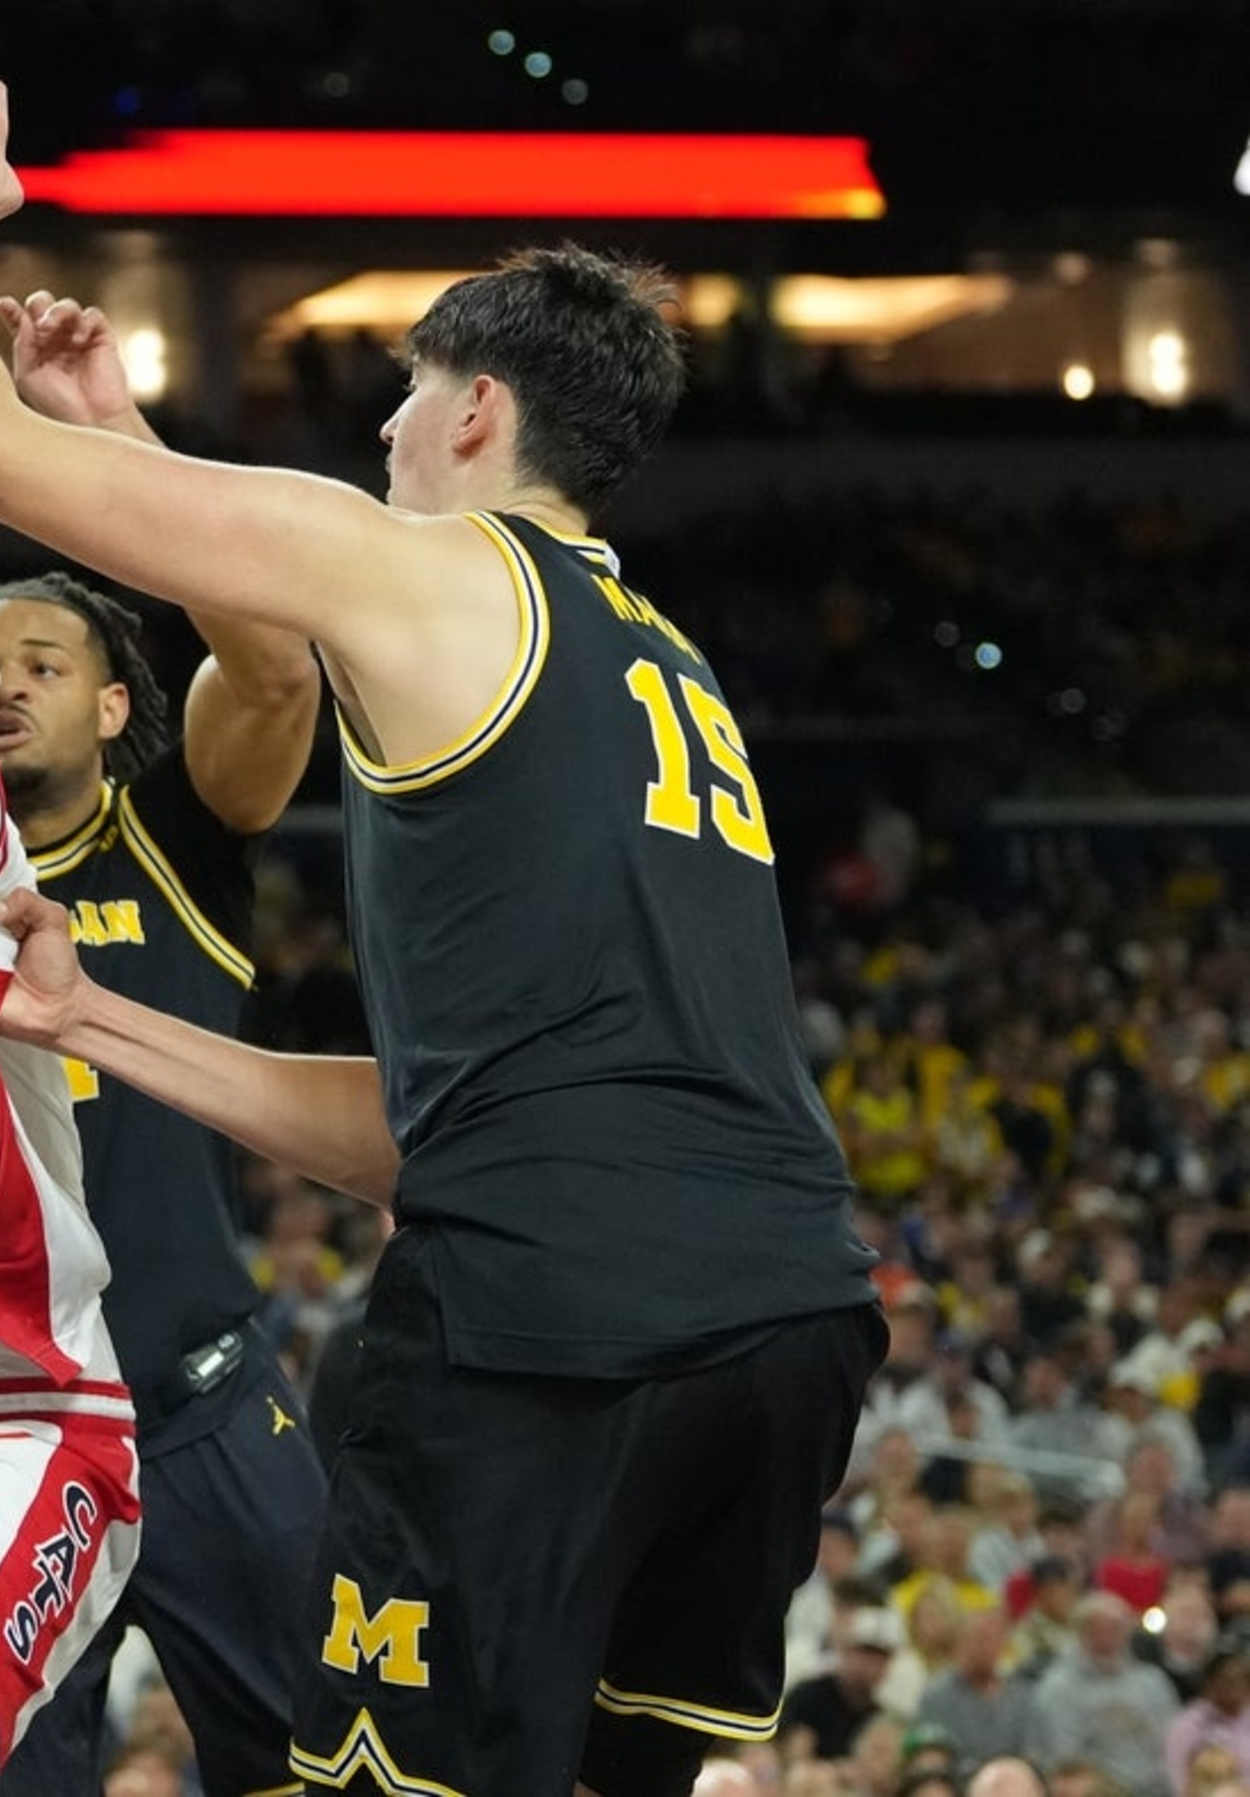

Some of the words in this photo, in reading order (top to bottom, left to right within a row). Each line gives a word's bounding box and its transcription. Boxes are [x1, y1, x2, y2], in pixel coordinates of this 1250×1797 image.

[625, 658, 775, 865] 15
[69, 899, 146, 947] AN
[3, 1480, 98, 1666] CATS
[321, 1572, 430, 1688] M
